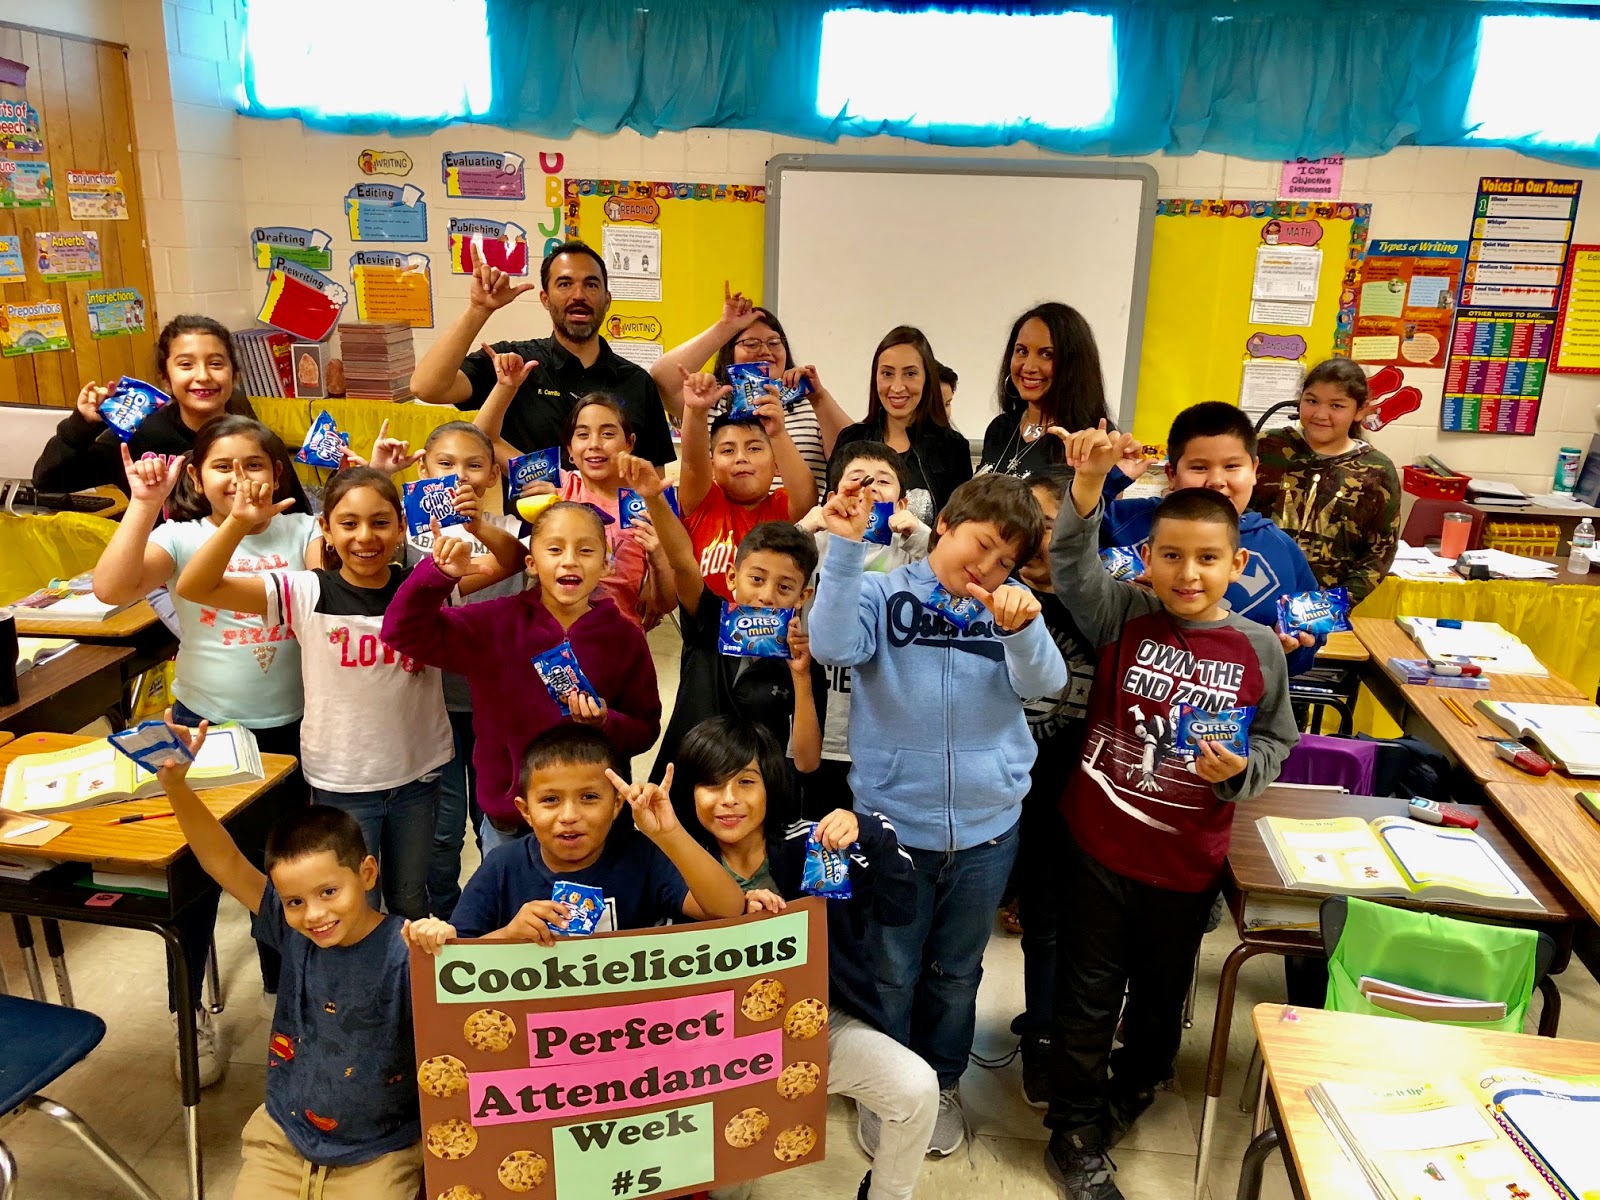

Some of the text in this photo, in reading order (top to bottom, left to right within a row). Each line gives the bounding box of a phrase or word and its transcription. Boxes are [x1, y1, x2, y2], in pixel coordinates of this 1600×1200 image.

[15, 101, 27, 118] of
[0, 119, 27, 135] eech
[375, 158, 407, 168] WRITING
[445, 154, 502, 169] Evaluating
[1322, 157, 1344, 165] TEKS
[66, 171, 117, 185] Conjunctions
[1291, 176, 1331, 185] Objective
[356, 184, 394, 200] Editing
[1481, 179, 1578, 195] Voices in Our Room!
[621, 205, 654, 215] READING
[450, 219, 500, 237] Publishing
[1286, 226, 1312, 237] MATH
[51, 235, 86, 248] Adverbs
[256, 229, 305, 246] Drafting
[1378, 241, 1459, 254] Types of Writing
[357, 252, 401, 267] Revising
[276, 256, 324, 289] Prewriting
[87, 291, 135, 305] Interjections
[1463, 288, 1472, 301] 5
[7, 303, 61, 319] Prepositions
[1405, 310, 1443, 319] Persuasive
[624, 322, 656, 333] WRITING
[1358, 318, 1398, 327] Descriptive
[1262, 342, 1300, 352] LANGUAGE
[119, 391, 147, 428] OREO
[517, 461, 548, 479] OREO
[525, 469, 546, 482] mini
[423, 482, 444, 495] Mini
[423, 491, 450, 512] Chips
[737, 617, 780, 629] OREO
[748, 627, 774, 636] mini
[1136, 639, 1245, 691] OWN THE
[1122, 665, 1174, 703] END
[1191, 721, 1239, 734] OREO
[1203, 732, 1232, 742] mini
[822, 850, 833, 879] mini
[831, 853, 842, 883] REO
[438, 936, 797, 995] Cookielicious
[532, 1009, 724, 1060] Perfect
[474, 1049, 774, 1119] Attendance
[568, 1109, 698, 1153] Week
[611, 1166, 663, 1196] #5
